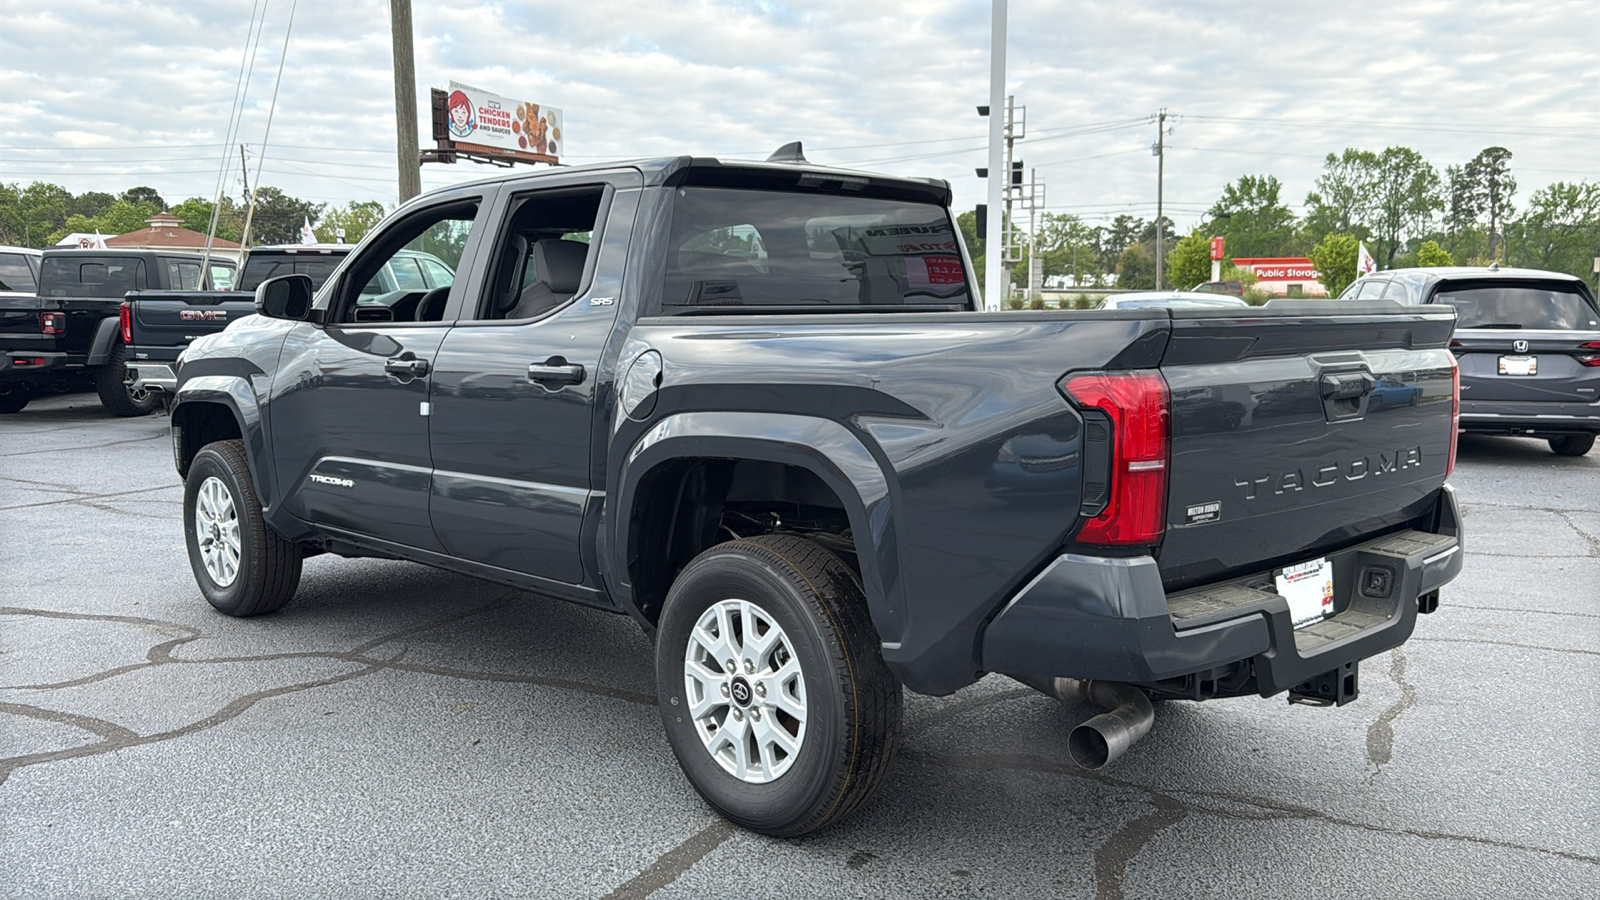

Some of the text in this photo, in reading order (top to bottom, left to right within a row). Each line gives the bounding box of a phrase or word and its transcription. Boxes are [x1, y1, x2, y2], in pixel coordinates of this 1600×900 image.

[478, 107, 511, 119] CHICKEN
[479, 115, 511, 128] TENDERS
[491, 126, 511, 135] SAUCES
[1256, 269, 1285, 278] Public
[590, 297, 614, 306] SR5
[180, 310, 227, 320] GMC
[1234, 446, 1422, 500] TACOMA
[310, 474, 355, 487] TACOMA
